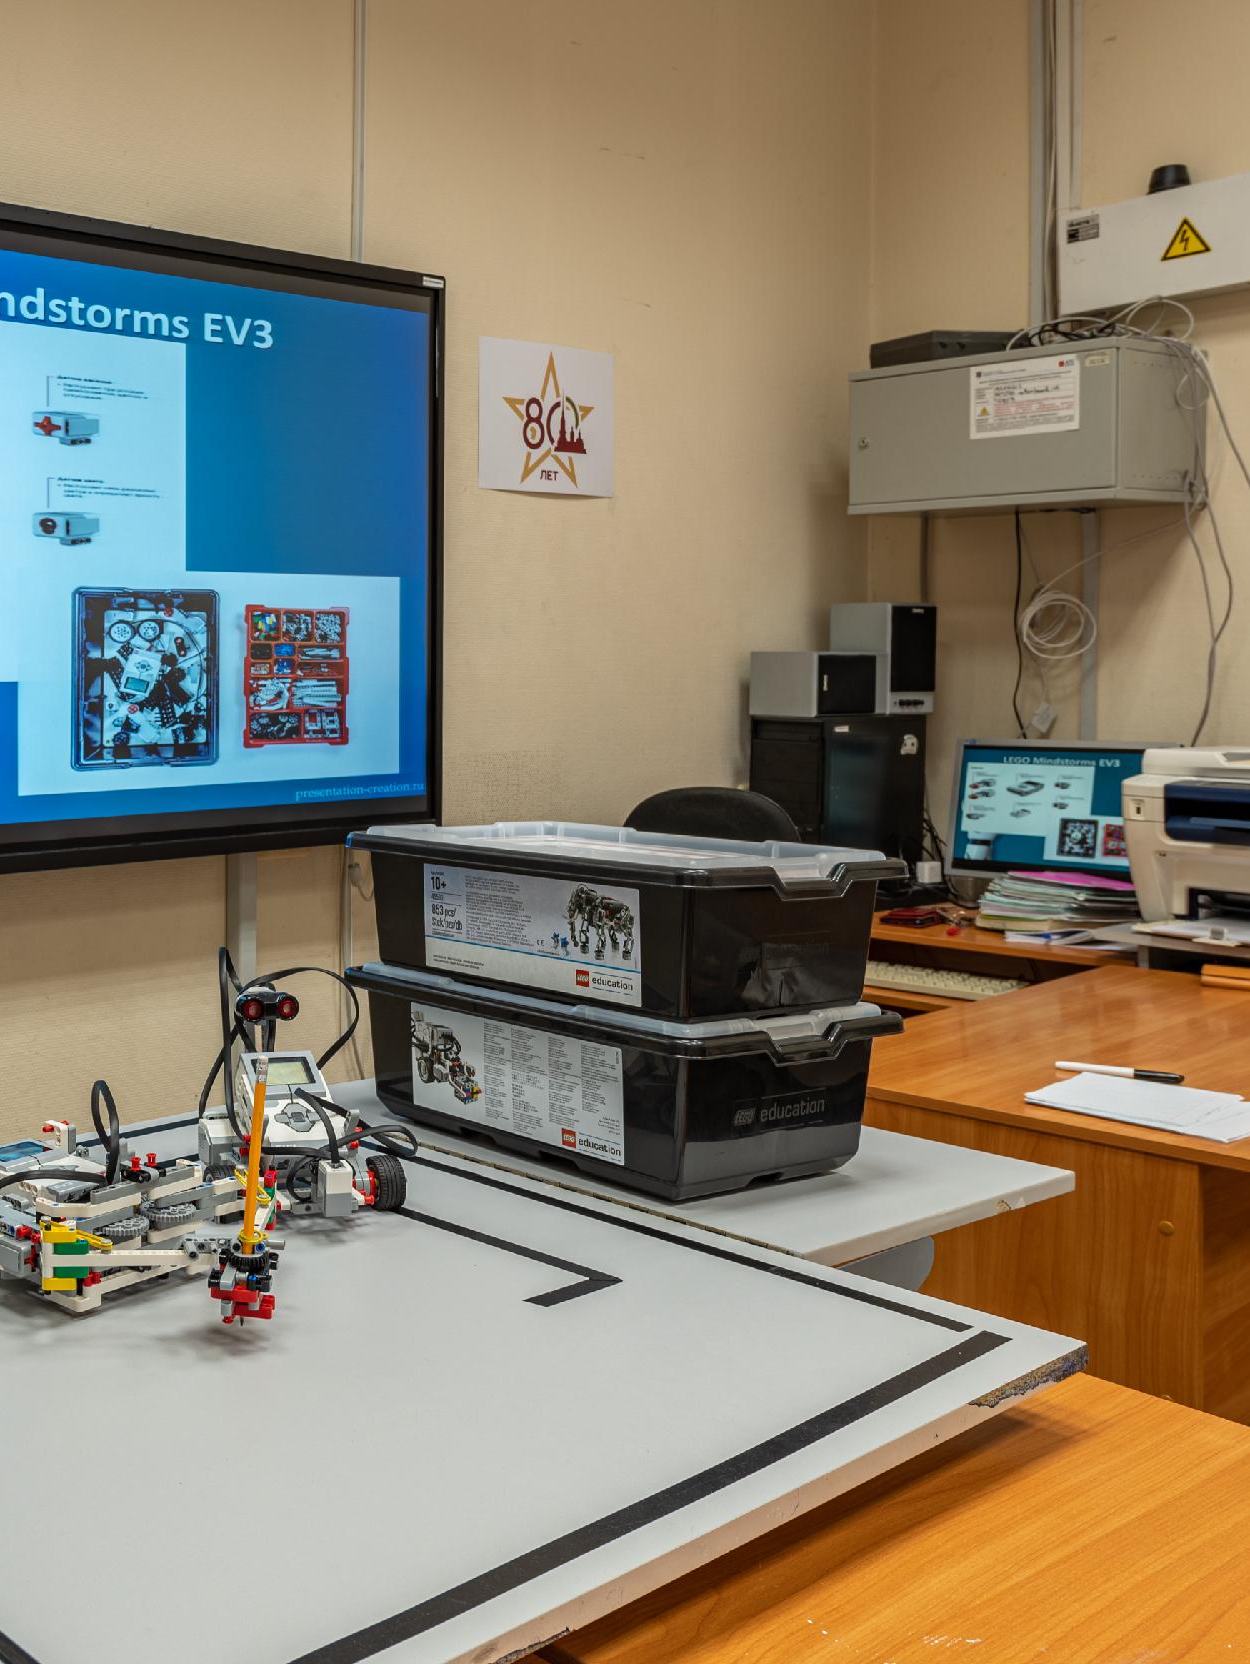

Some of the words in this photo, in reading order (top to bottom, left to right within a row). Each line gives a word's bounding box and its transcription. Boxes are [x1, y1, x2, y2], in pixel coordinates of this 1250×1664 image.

[203, 312, 274, 350] EV3
[539, 469, 559, 481] ЛЕТ
[1003, 755, 1030, 764] LEGO
[1034, 756, 1096, 767] Mindstorms
[1099, 759, 1120, 768] EV3
[295, 781, 425, 802] presentation-creation.ru
[431, 876, 447, 890] 10+
[592, 976, 634, 991] education
[760, 1096, 825, 1122] education
[578, 1138, 621, 1157] education
